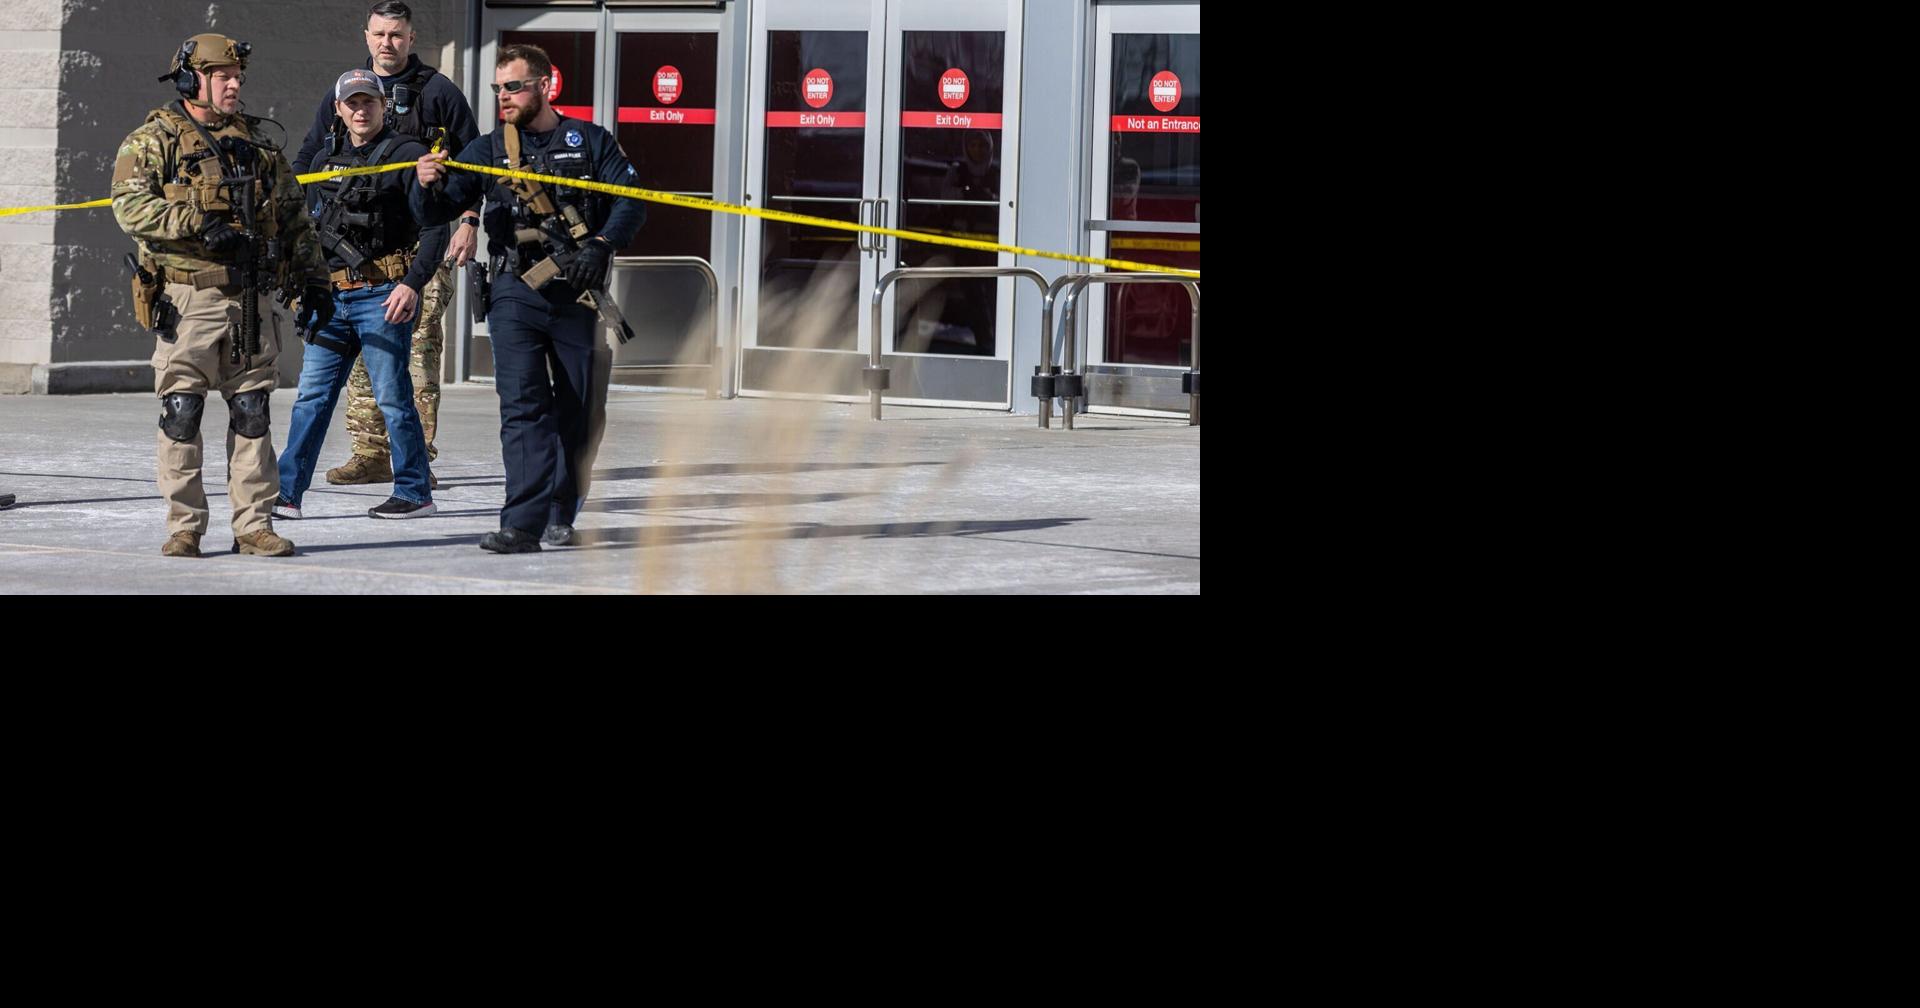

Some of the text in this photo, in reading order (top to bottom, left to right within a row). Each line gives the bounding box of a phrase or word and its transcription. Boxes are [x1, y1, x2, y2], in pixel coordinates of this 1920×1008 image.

[650, 110, 684, 123] Exit Only
[800, 114, 835, 127] Exit Only
[936, 115, 971, 128] Exit Only
[1128, 118, 1200, 130] Not an Entranc
